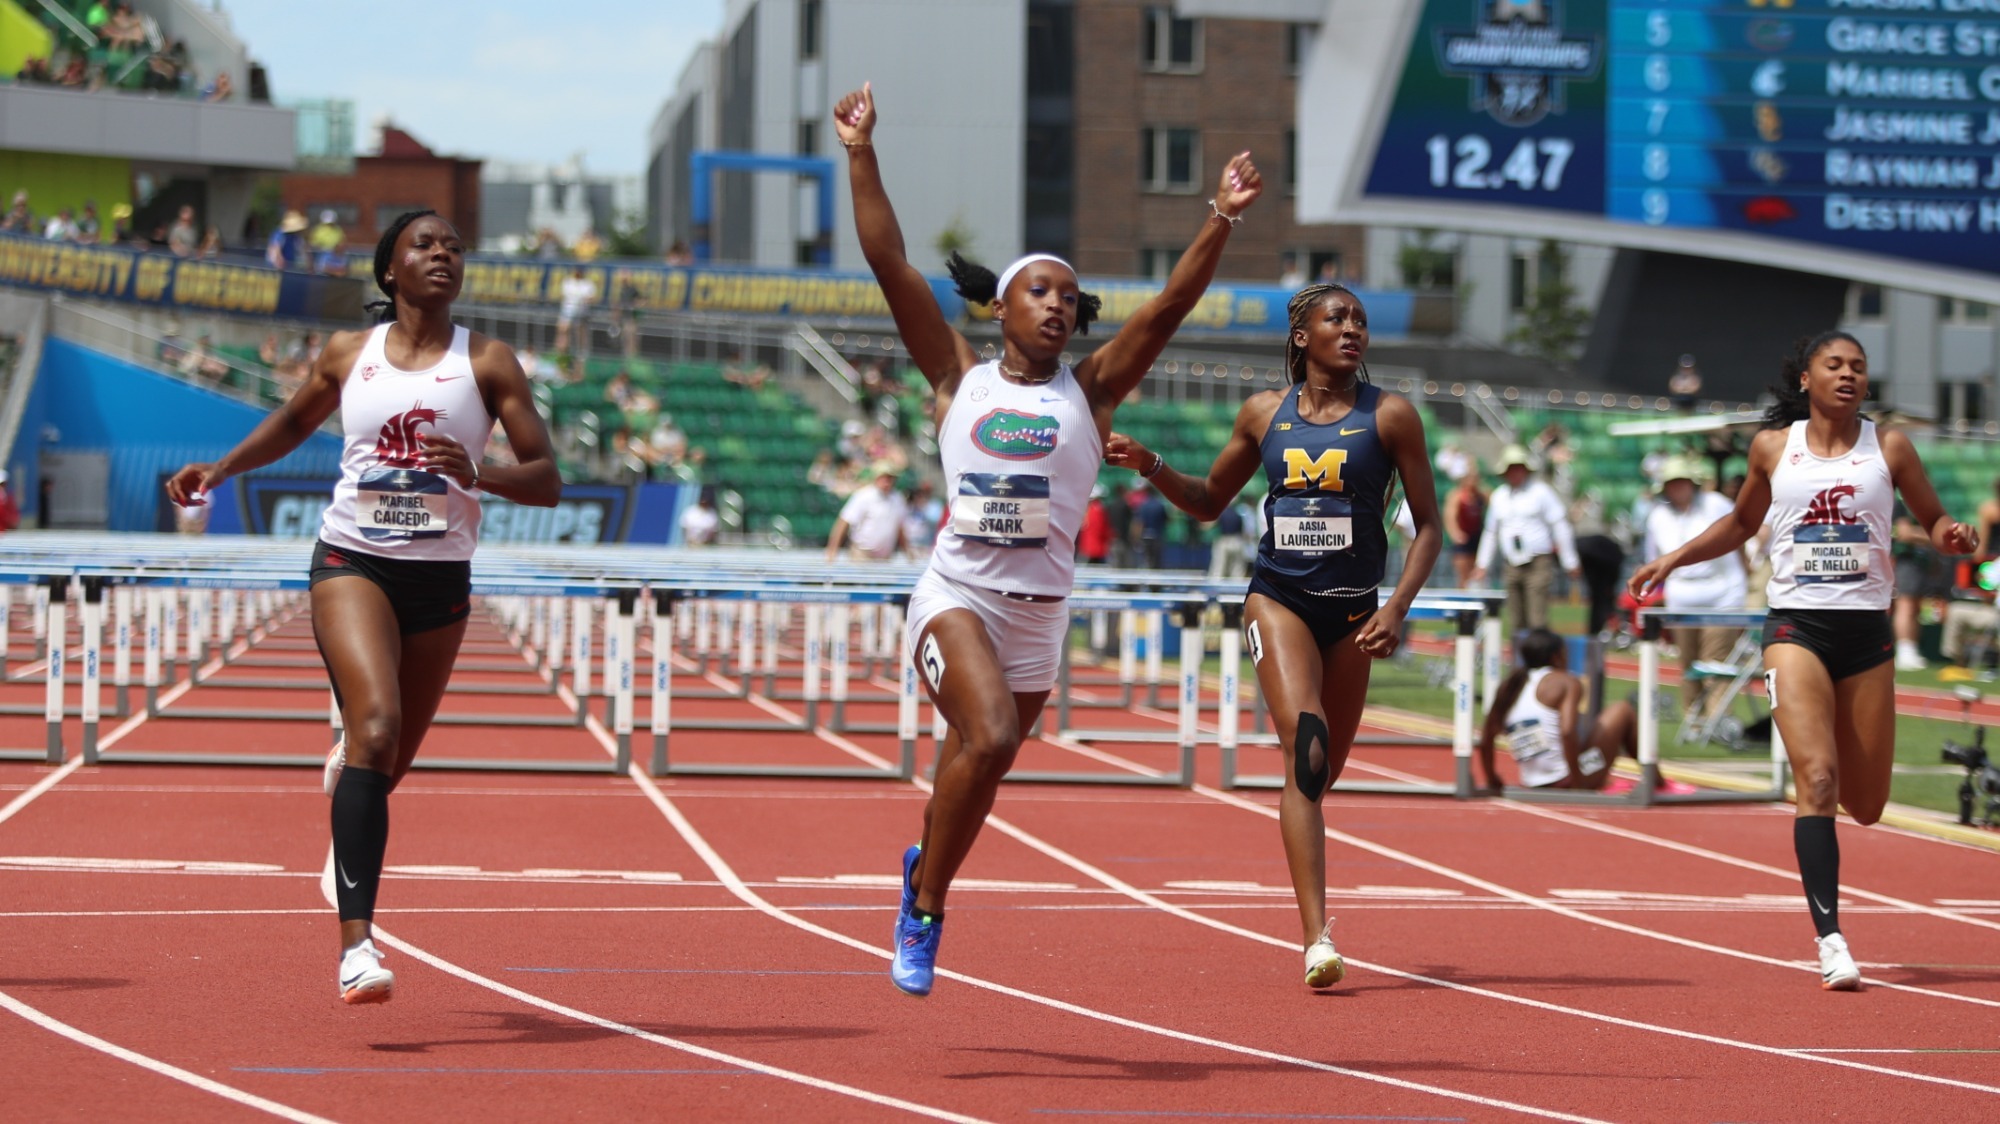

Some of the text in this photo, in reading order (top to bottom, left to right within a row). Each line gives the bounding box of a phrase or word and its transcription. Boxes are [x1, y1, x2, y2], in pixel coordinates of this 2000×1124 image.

[1645, 9, 1672, 46] 5
[1826, 16, 1949, 55] GRACE
[1643, 54, 1671, 92] 6
[1826, 60, 1975, 100] MARIBEL
[1645, 98, 1670, 135] 7
[1824, 104, 1973, 145] JASMINE
[1425, 133, 1575, 191] 12.47
[1642, 142, 1670, 181] 8
[1825, 149, 1978, 189] RAYNIAH
[1641, 189, 1669, 226] 9
[1824, 193, 1975, 233] DESTINY
[0, 239, 134, 297] NIVERSITY
[135, 256, 173, 300] OF
[172, 261, 282, 316] OREGON
[1283, 448, 1348, 492] M
[374, 508, 430, 527] CAICEDO
[379, 494, 425, 509] MARIBEL
[983, 501, 1021, 515] GRACE
[979, 517, 1024, 534] STARK
[1281, 533, 1346, 547] LAURENCIN
[1299, 521, 1327, 531] AASIA
[1804, 559, 1859, 572] DE MELLO
[1811, 547, 1852, 557] MICAELA
[924, 643, 940, 687] 5
